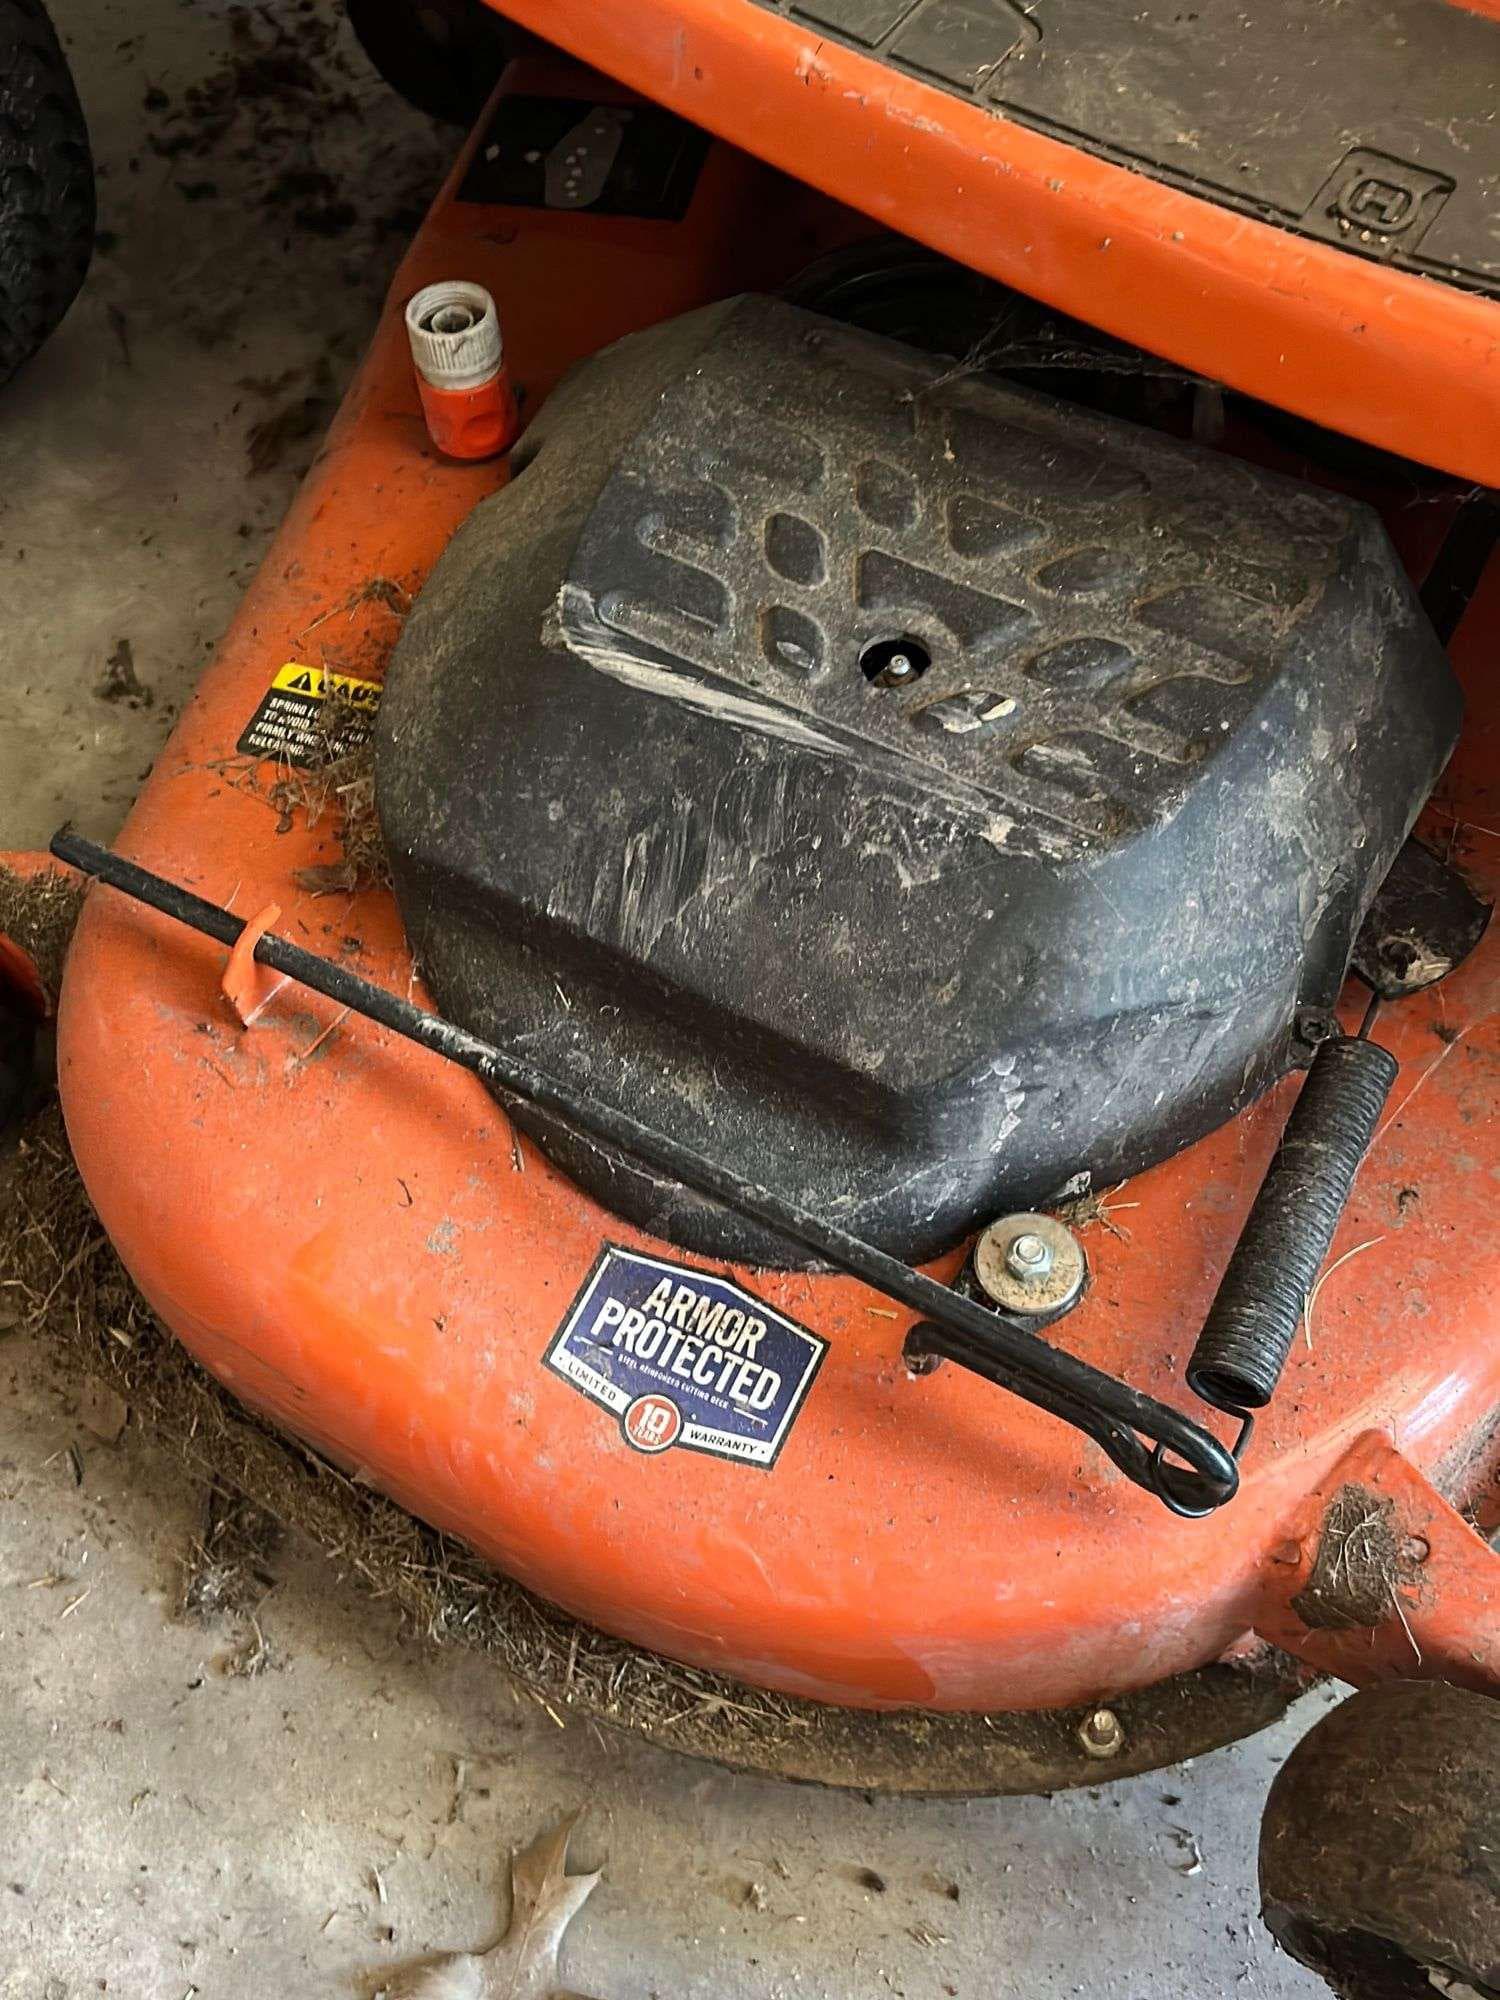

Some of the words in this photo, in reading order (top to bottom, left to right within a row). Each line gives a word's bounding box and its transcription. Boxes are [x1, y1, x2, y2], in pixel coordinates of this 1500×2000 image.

[264, 709, 278, 720] TO
[278, 715, 310, 731] AVOID
[269, 697, 308, 716] SPRING
[255, 721, 296, 740] FIRMLY
[248, 733, 305, 757] RELEANG.
[641, 1277, 767, 1359] ARMOR
[590, 1296, 782, 1411] PROTECTED
[568, 1361, 617, 1402] LIMITED
[618, 1353, 637, 1369] STEEL
[639, 1364, 680, 1388] REINFORCED
[681, 1383, 710, 1401] CUTTING
[710, 1395, 730, 1409] DECK
[638, 1403, 672, 1435] 10
[690, 1430, 757, 1454] WARRANTY
